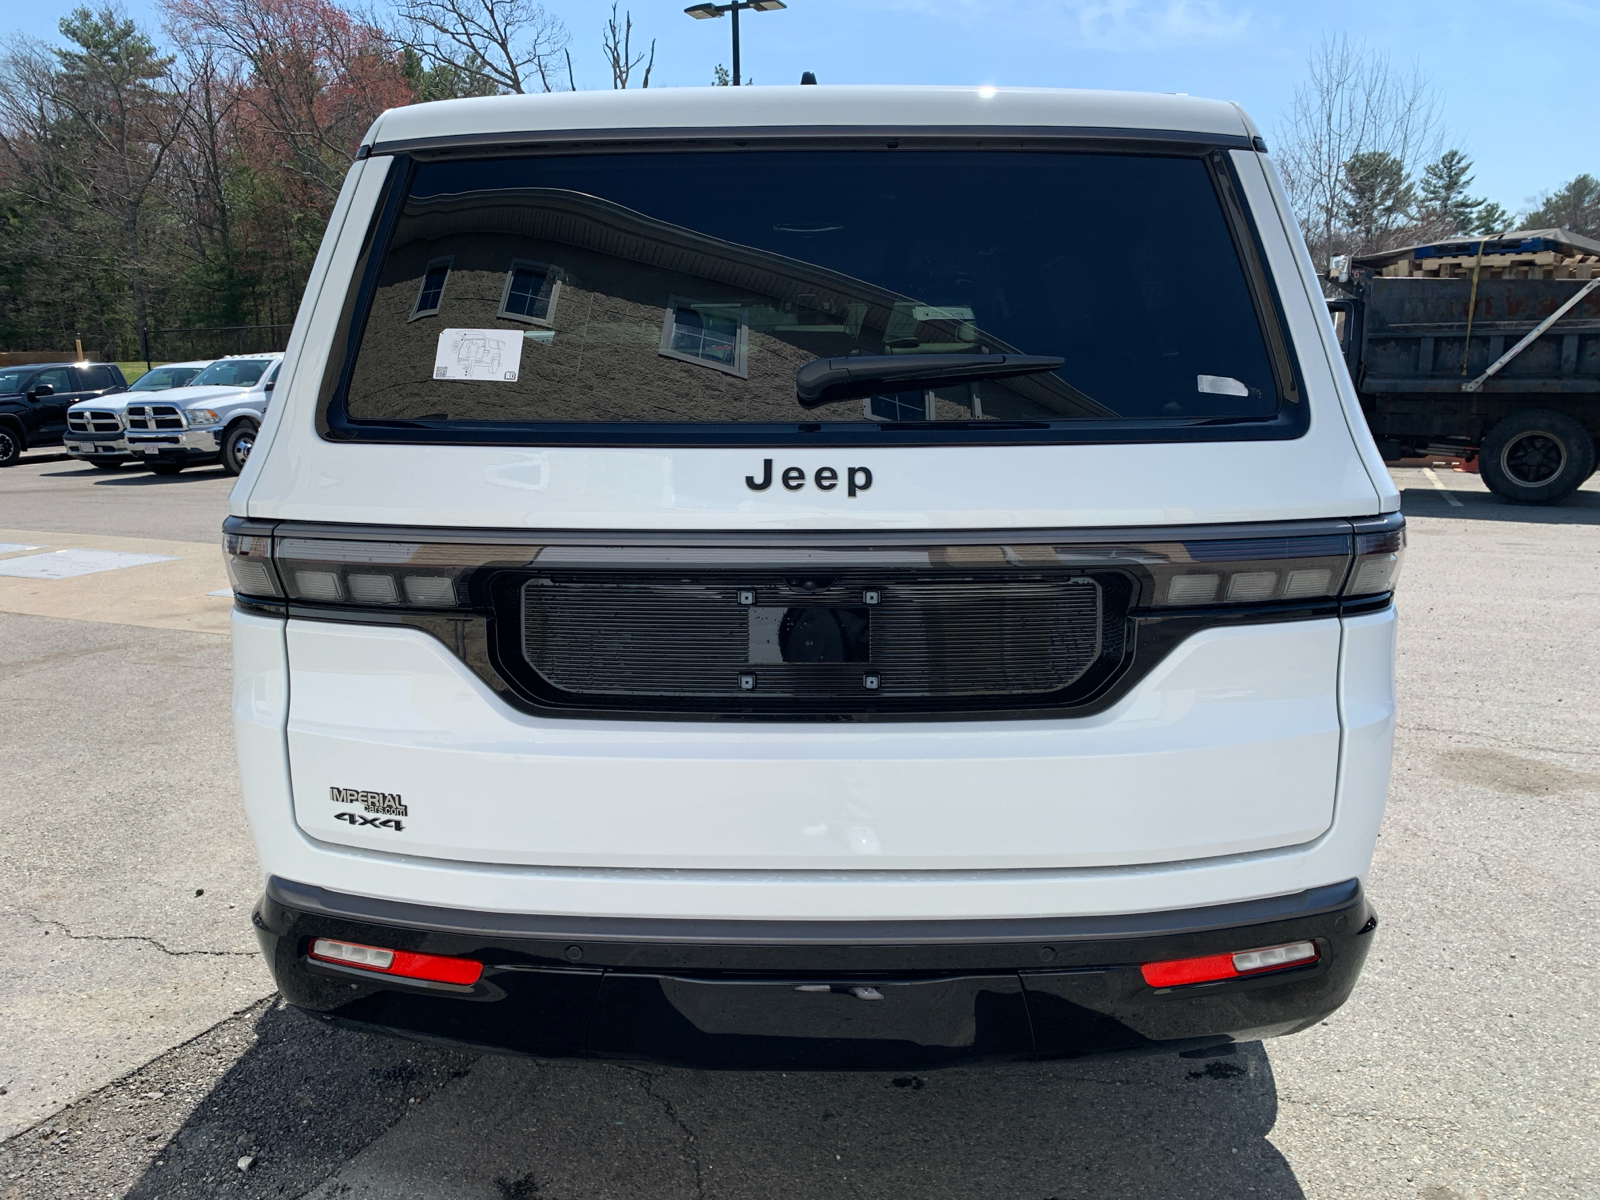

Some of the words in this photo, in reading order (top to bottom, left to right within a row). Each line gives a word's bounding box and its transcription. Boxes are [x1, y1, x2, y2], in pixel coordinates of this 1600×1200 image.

[745, 458, 873, 498] Jeep
[329, 786, 407, 810] IMPERIAL
[364, 803, 408, 817] cars.com
